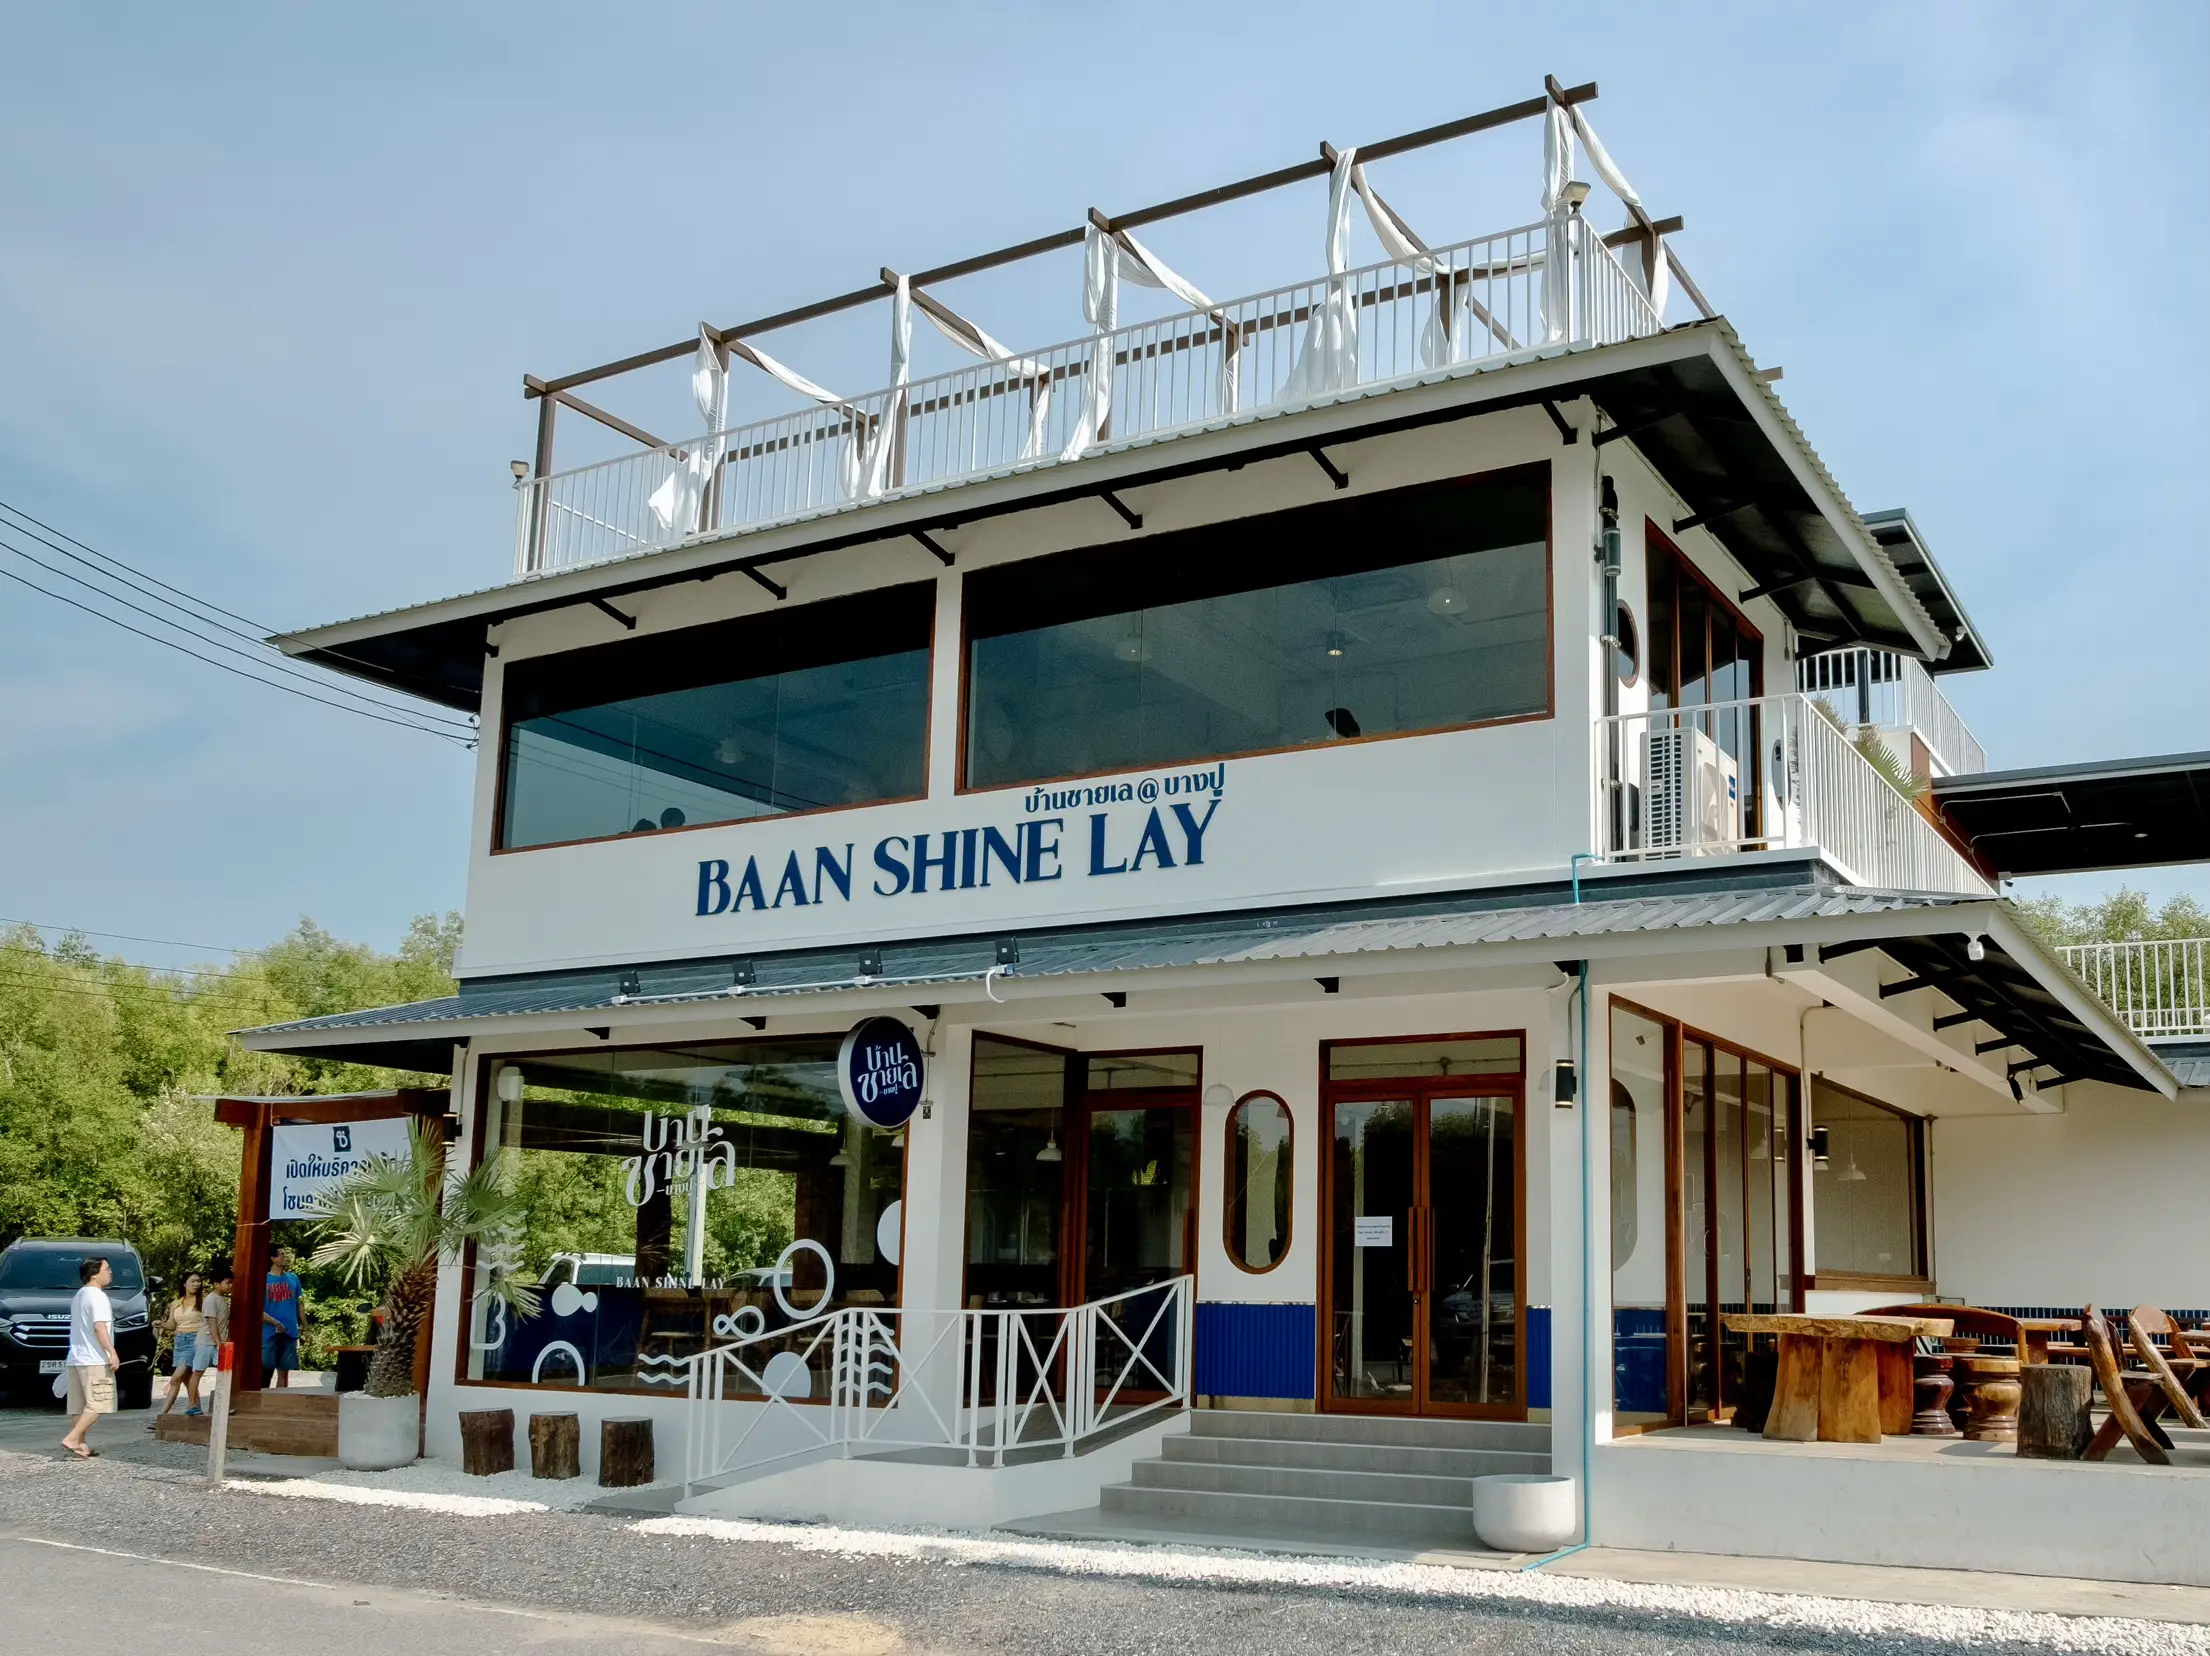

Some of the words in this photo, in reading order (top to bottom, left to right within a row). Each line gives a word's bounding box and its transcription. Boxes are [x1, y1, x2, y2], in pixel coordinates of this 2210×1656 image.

[1025, 783, 1133, 813] บ้านชายเล
[1164, 762, 1225, 797] บางปู
[695, 842, 855, 917] BAAN
[873, 817, 1064, 897] SHINE
[1087, 798, 1222, 876] LAY
[865, 1041, 909, 1071] บ้าน
[643, 1103, 724, 1152] บ้าน
[616, 1276, 650, 1288] BAAN
[701, 1277, 725, 1290] LAY
